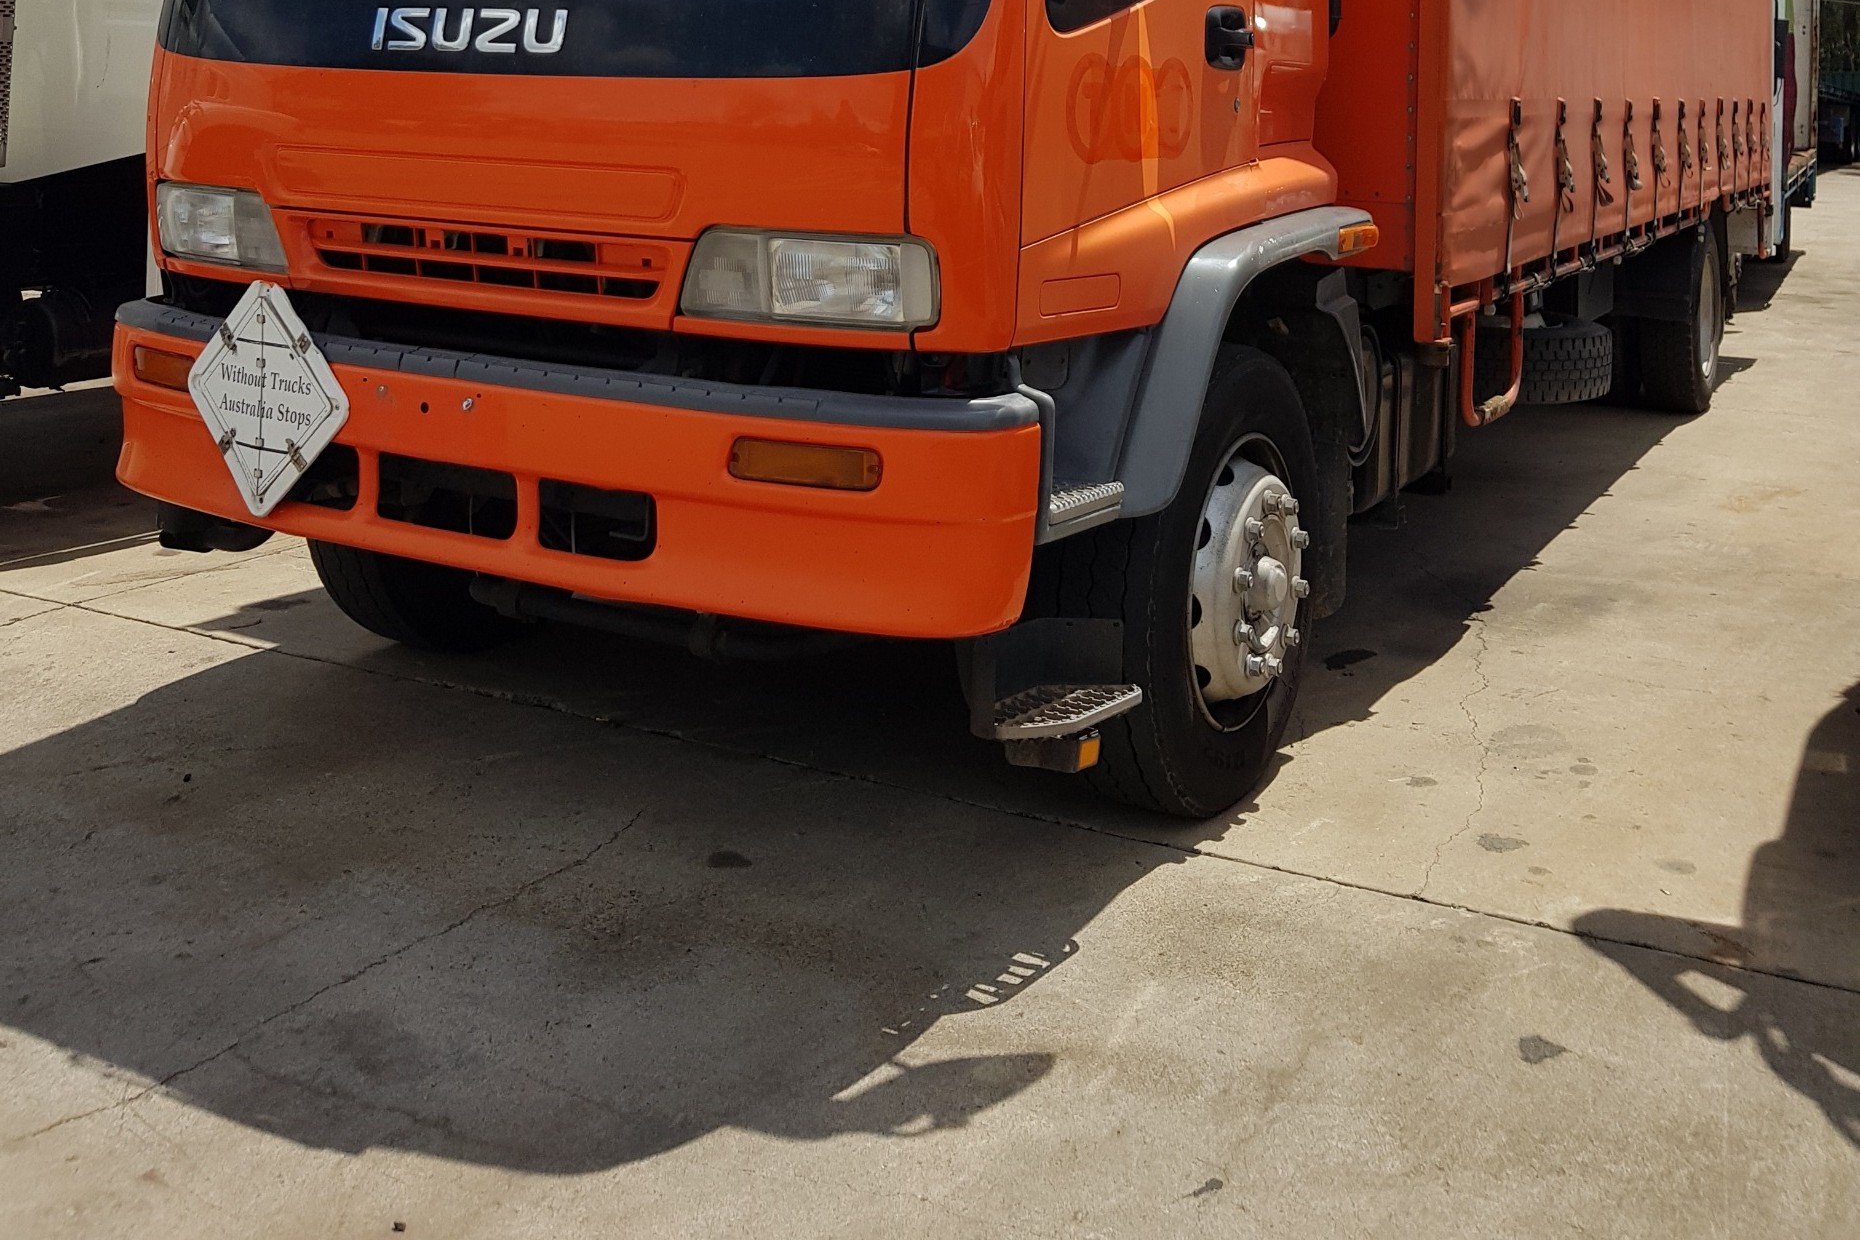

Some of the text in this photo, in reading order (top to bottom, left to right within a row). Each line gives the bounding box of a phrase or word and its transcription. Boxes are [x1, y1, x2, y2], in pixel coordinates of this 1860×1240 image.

[371, 7, 569, 53] ISUZU
[220, 363, 312, 396] Without Trucks
[219, 393, 312, 430] Australia Stops
